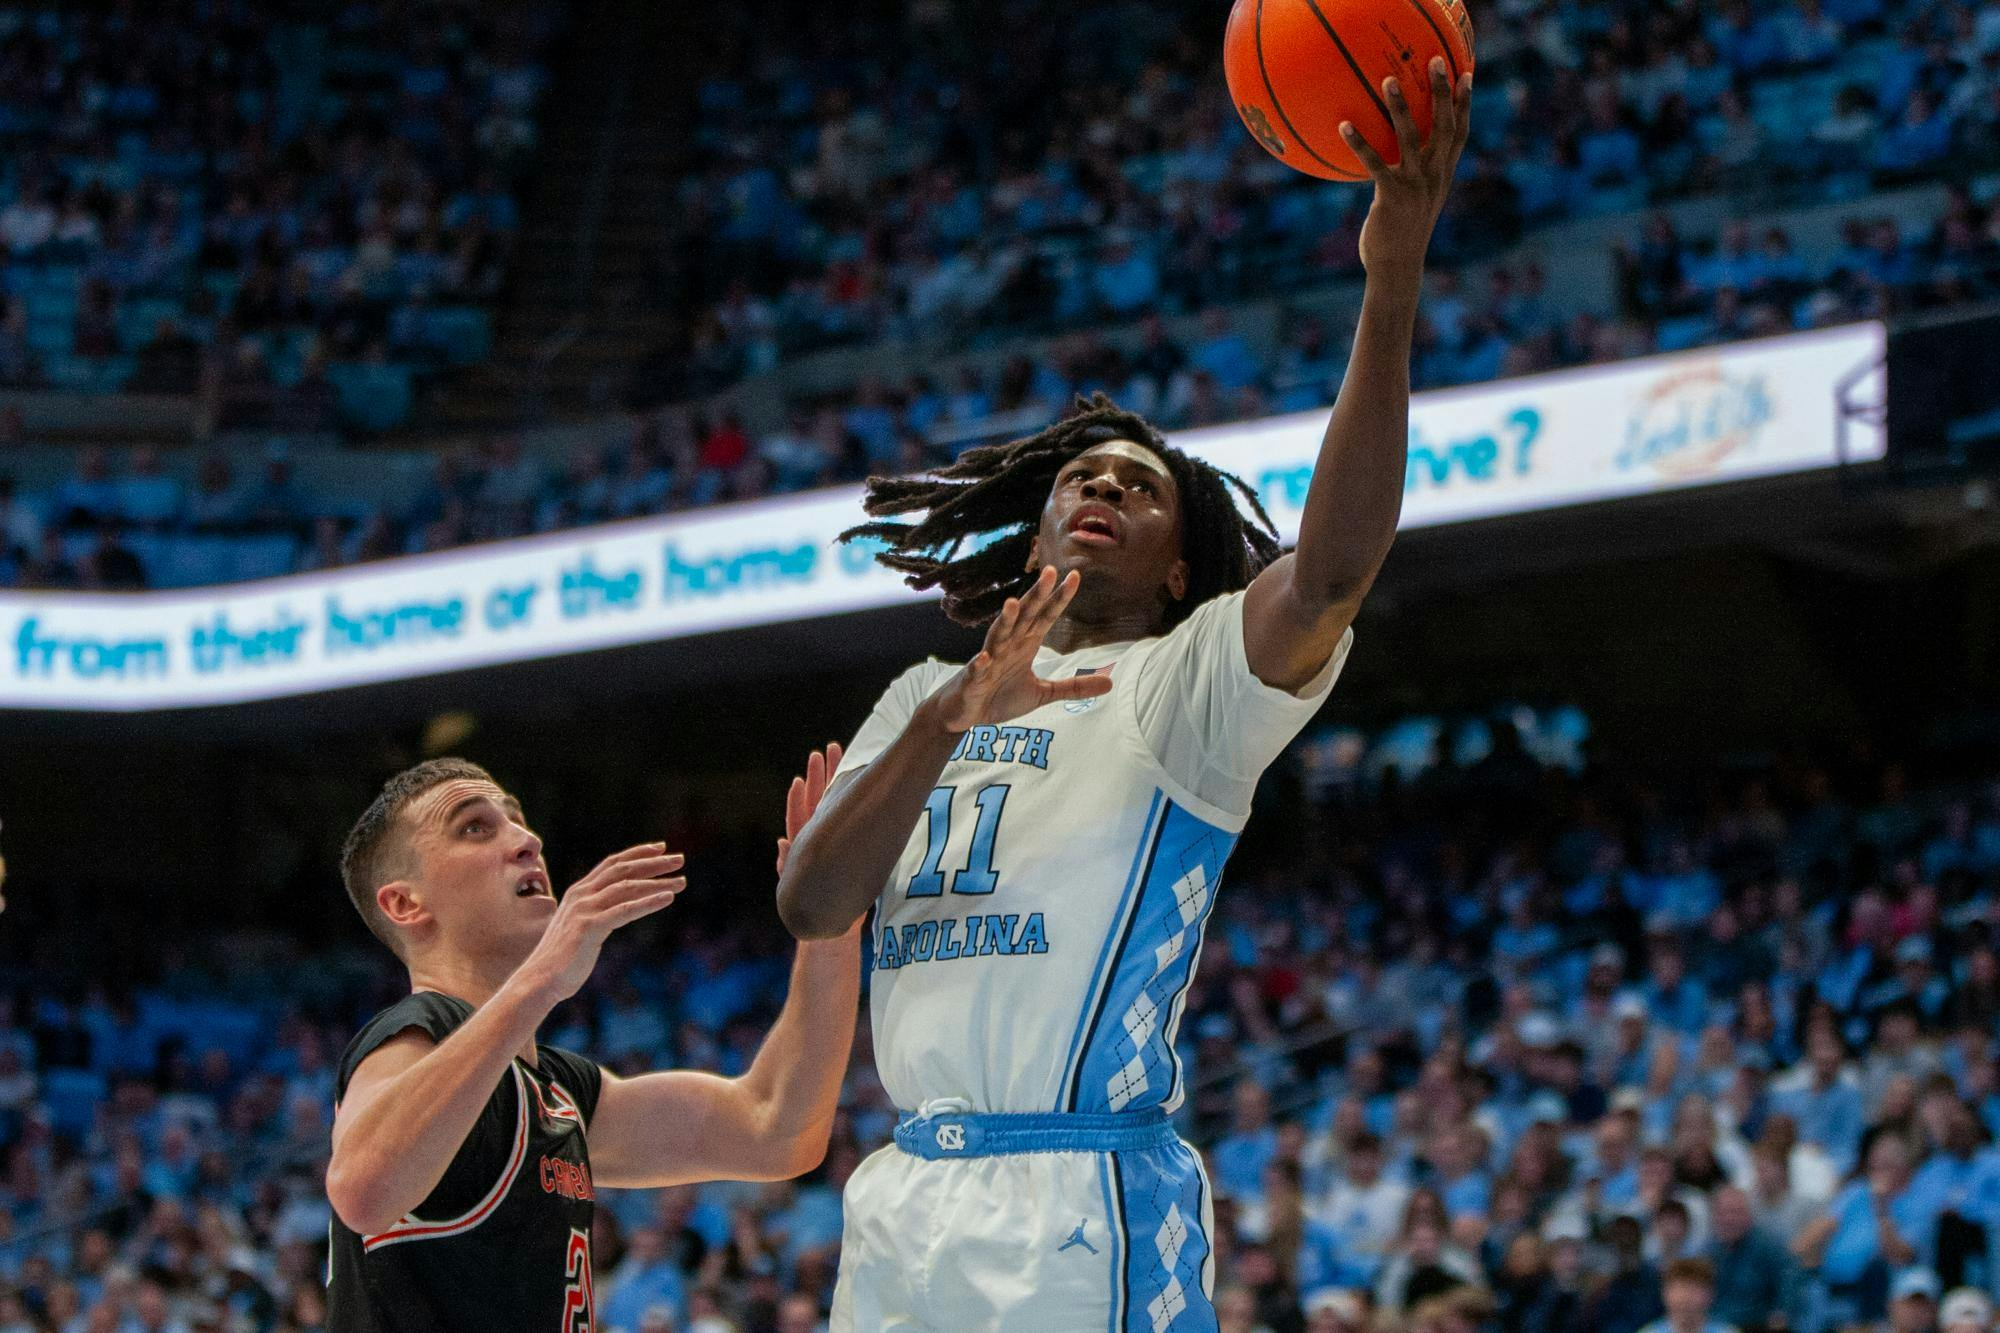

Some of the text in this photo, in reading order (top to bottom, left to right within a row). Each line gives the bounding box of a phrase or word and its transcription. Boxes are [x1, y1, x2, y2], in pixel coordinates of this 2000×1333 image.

[13, 615, 166, 677] from
[188, 606, 307, 674] their
[324, 594, 465, 654] home
[484, 580, 538, 632] or
[557, 552, 643, 617] the
[662, 537, 819, 600] home
[948, 724, 1055, 770] RTH
[906, 784, 1011, 899] 11
[873, 912, 1049, 970] AROLINA
